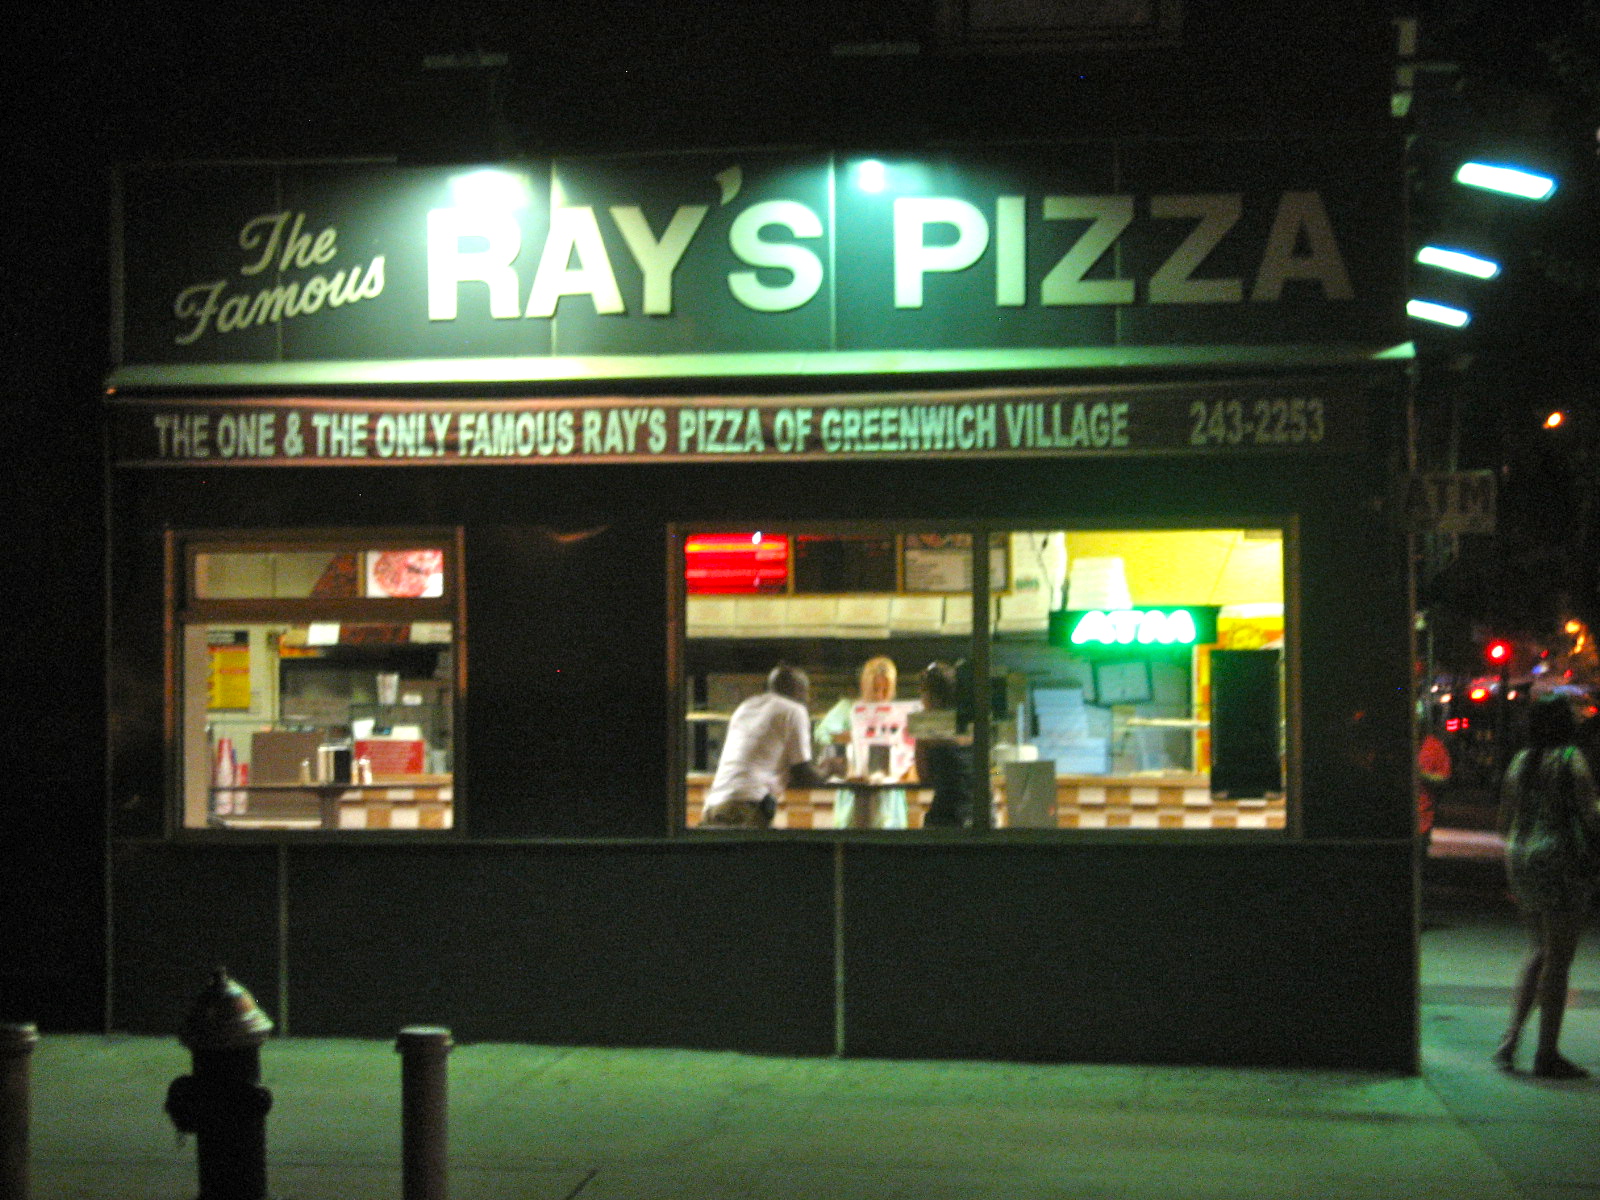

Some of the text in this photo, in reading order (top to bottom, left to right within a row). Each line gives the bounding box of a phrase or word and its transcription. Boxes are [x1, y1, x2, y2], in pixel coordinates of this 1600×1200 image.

[239, 211, 338, 275] The
[427, 165, 1356, 321] RAY'S PIZZA
[174, 253, 386, 345] Famous
[154, 401, 1130, 457] THE ONE & THE ONLY FAMOUS RAY'S PIZZA OF GREENWICH VILLAGE
[1189, 399, 1326, 445] 243-2253
[1071, 609, 1197, 644] ATM
